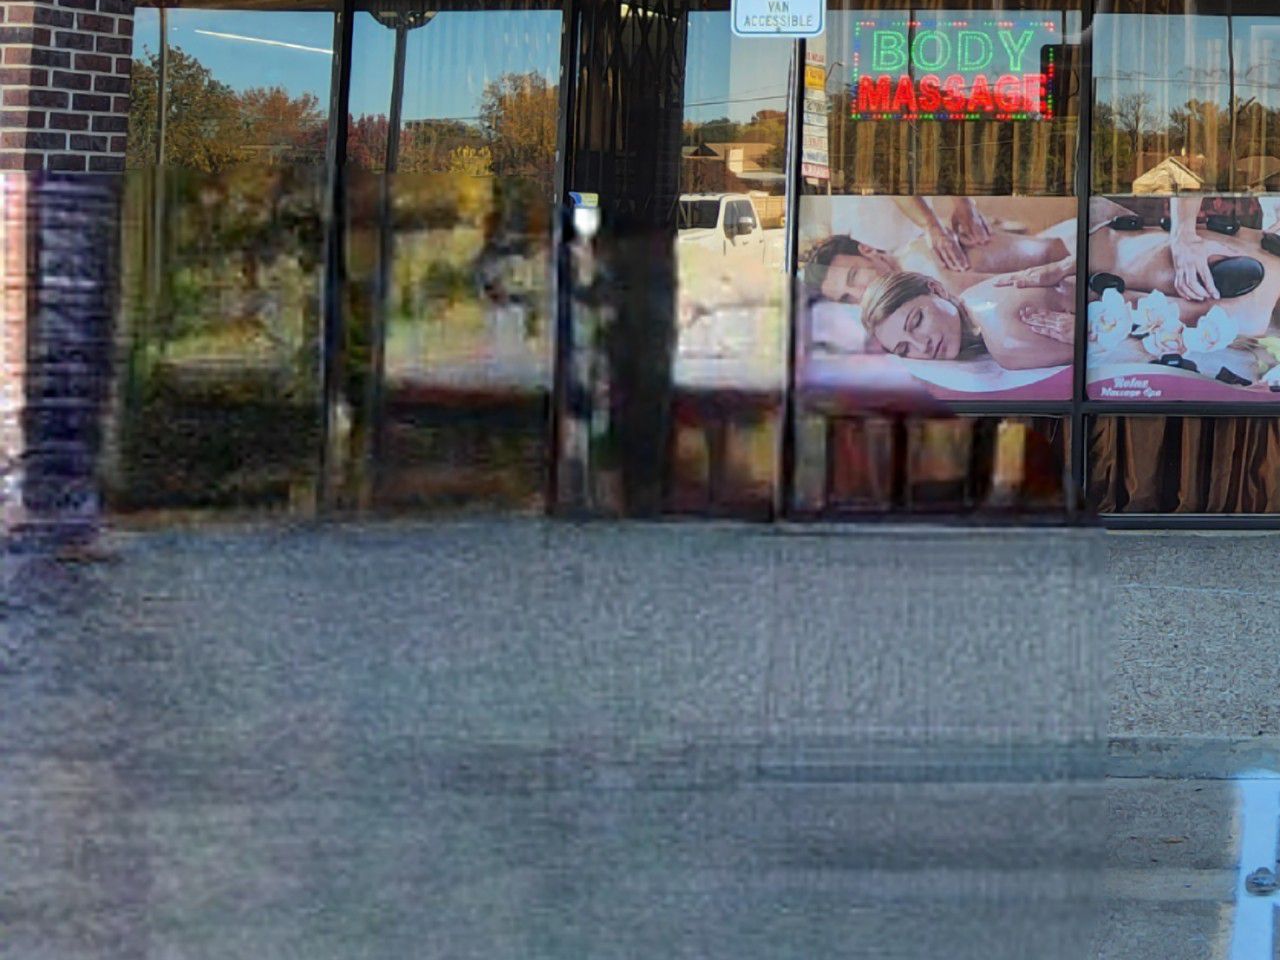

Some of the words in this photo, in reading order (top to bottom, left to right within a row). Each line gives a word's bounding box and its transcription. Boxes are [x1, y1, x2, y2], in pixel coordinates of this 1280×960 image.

[767, 1, 790, 13] VAN
[743, 15, 813, 27] ACCESSIBLE
[872, 29, 1034, 72] BODY
[857, 73, 1048, 113] MASSAGE
